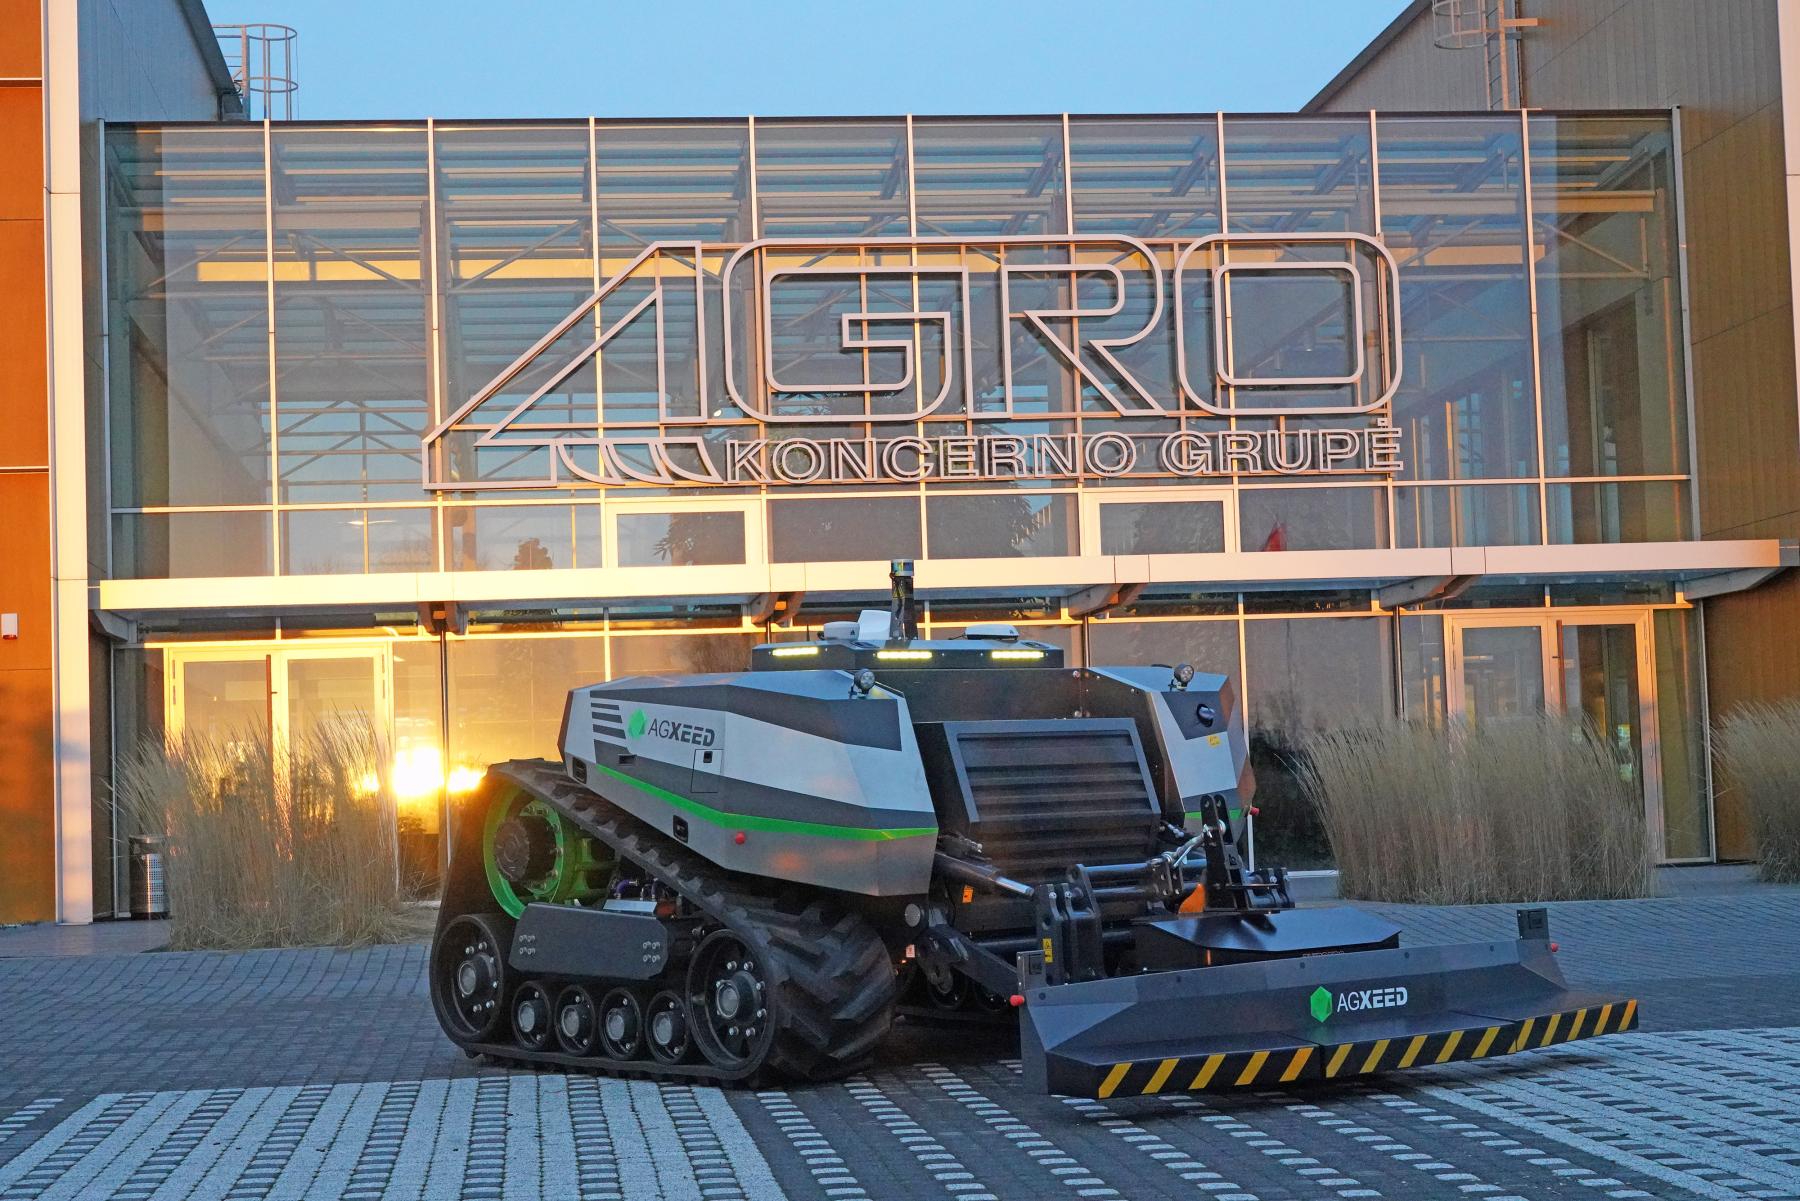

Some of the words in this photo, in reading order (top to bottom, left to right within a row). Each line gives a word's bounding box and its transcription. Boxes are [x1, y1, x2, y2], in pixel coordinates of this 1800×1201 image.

[421, 232, 1403, 490] AGRO
[725, 431, 1138, 484] KONCERNO
[1161, 417, 1404, 477] GRUPĖ
[648, 718, 715, 747] AGXEED
[1337, 986, 1408, 1012] AGXEED
